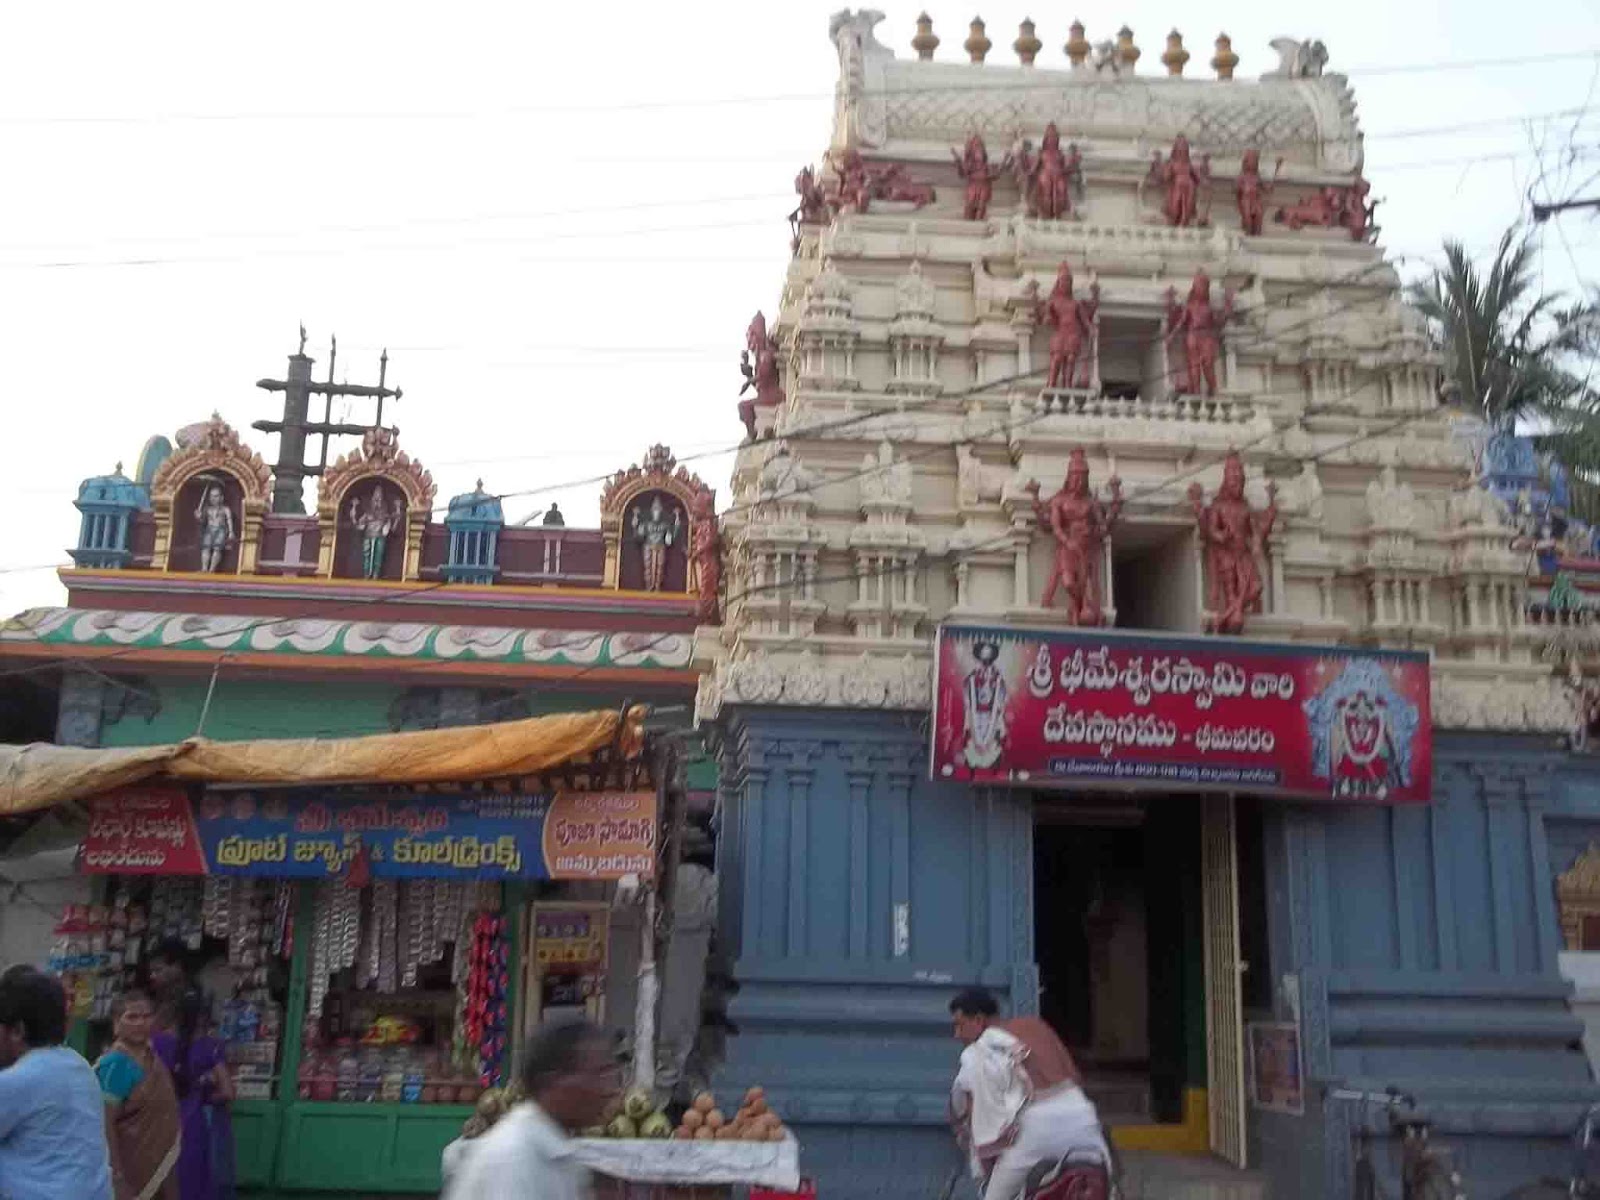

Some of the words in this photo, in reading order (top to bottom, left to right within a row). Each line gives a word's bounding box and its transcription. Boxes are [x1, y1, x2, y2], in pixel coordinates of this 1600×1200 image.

[1026, 642, 1053, 698] శ్రీ
[1060, 645, 1246, 709] భీమేశ్వరస్వామి
[1044, 702, 1176, 758] దేవస్థానము
[1195, 721, 1274, 752] భీమవరం
